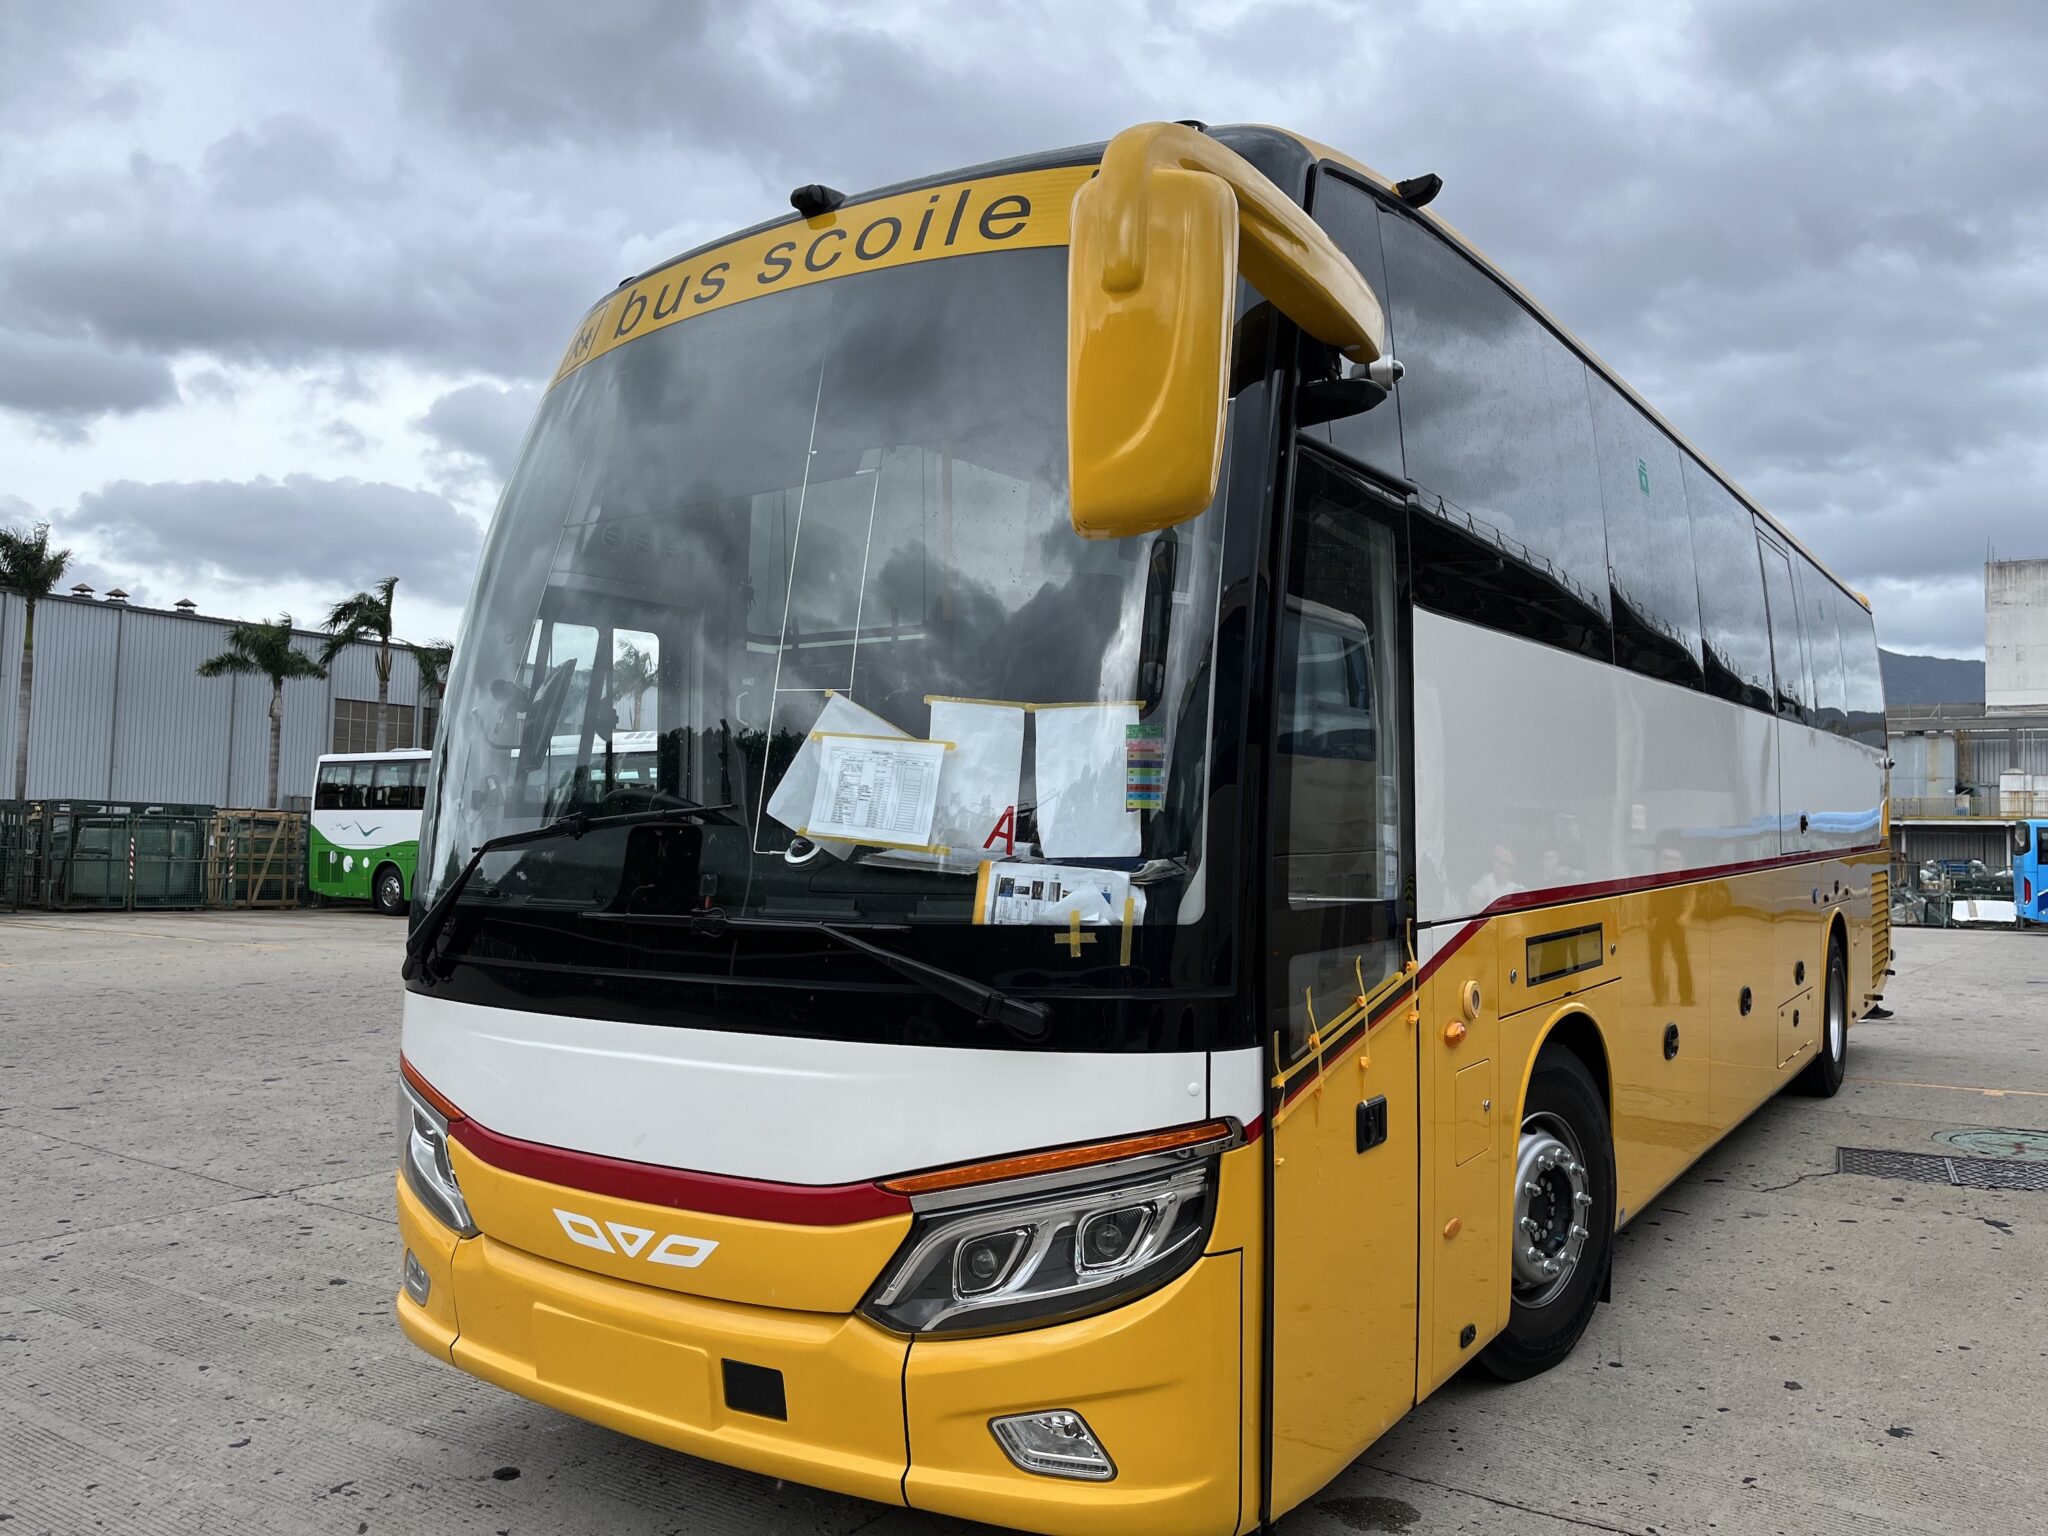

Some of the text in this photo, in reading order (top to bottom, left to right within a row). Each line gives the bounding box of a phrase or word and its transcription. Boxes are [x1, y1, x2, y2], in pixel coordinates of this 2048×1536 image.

[613, 189, 1032, 339] bus scoile
[983, 806, 1014, 856] A
